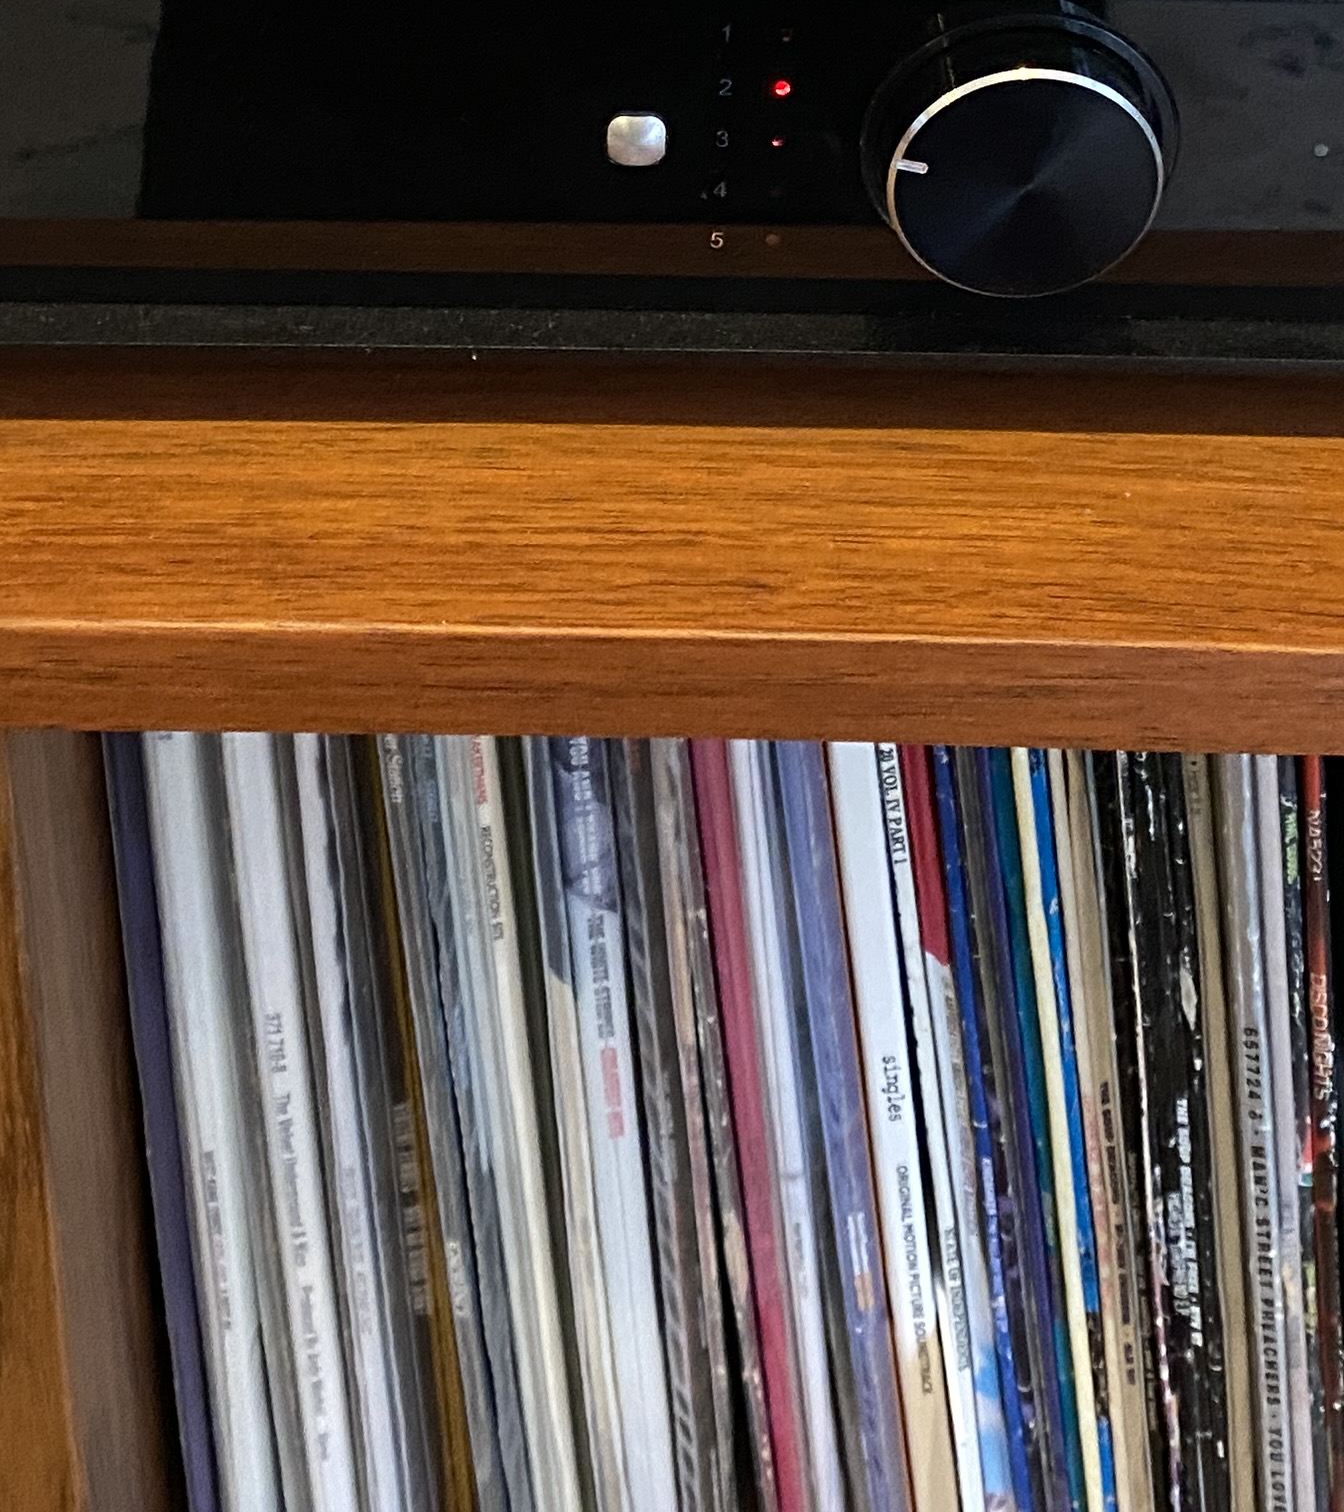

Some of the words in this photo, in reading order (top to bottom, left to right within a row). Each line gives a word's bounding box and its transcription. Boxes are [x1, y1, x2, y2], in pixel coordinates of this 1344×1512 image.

[722, 25, 732, 42] 1
[719, 79, 733, 96] 2
[716, 131, 729, 148] 3
[713, 182, 728, 198] 4
[710, 232, 725, 249] 5
[881, 764, 899, 796] VOL
[885, 797, 901, 814] IV
[887, 816, 907, 854] PART
[880, 1054, 904, 1123] singles
[895, 1165, 914, 1223] ORIGINAL
[901, 1223, 920, 1271] MOTION
[1255, 1217, 1275, 1290] STREET
[907, 1272, 926, 1320] PICTURE
[1259, 1297, 1283, 1406] PREACHERS
[1266, 1426, 1285, 1464] YOU
